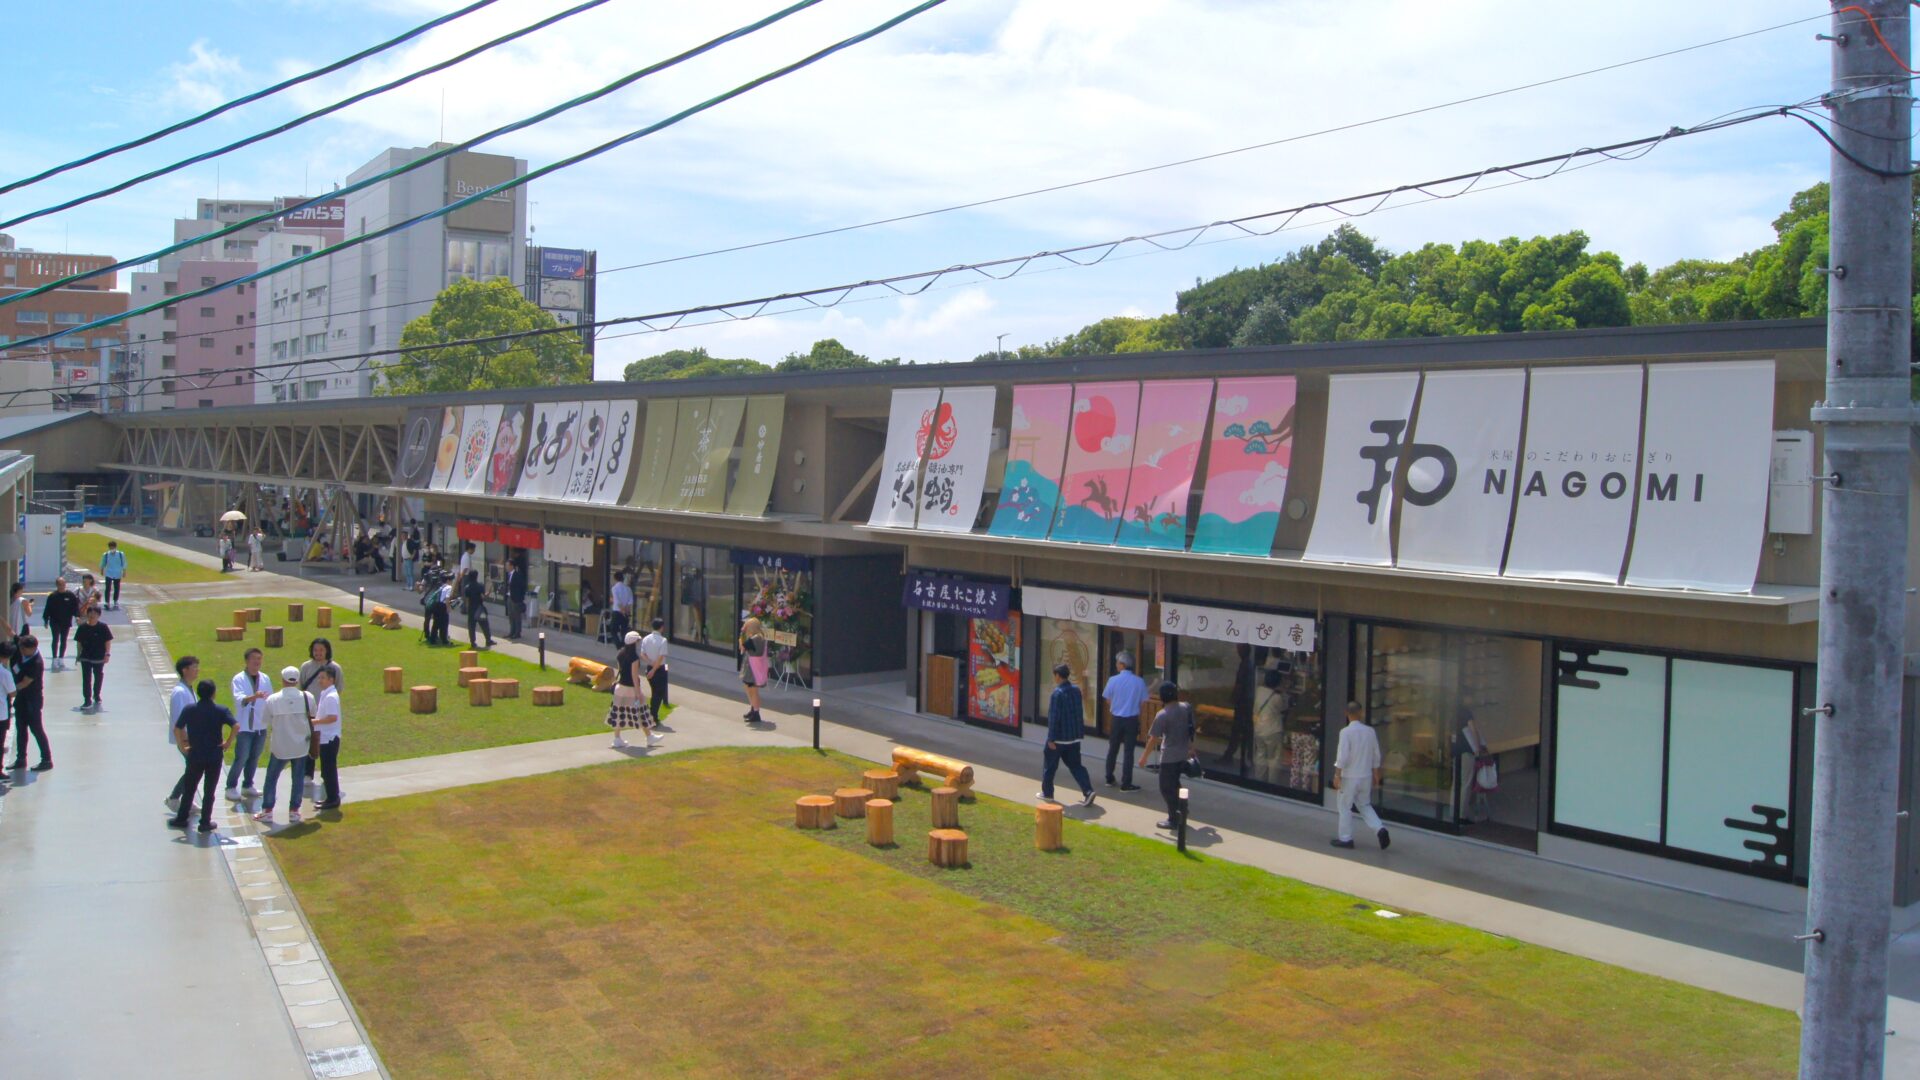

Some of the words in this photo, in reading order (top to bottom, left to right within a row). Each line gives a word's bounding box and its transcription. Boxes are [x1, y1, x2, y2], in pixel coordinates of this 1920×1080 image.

[1482, 468, 1704, 503] NAGOMI
[913, 579, 997, 606] 名古屋たこ焼き
